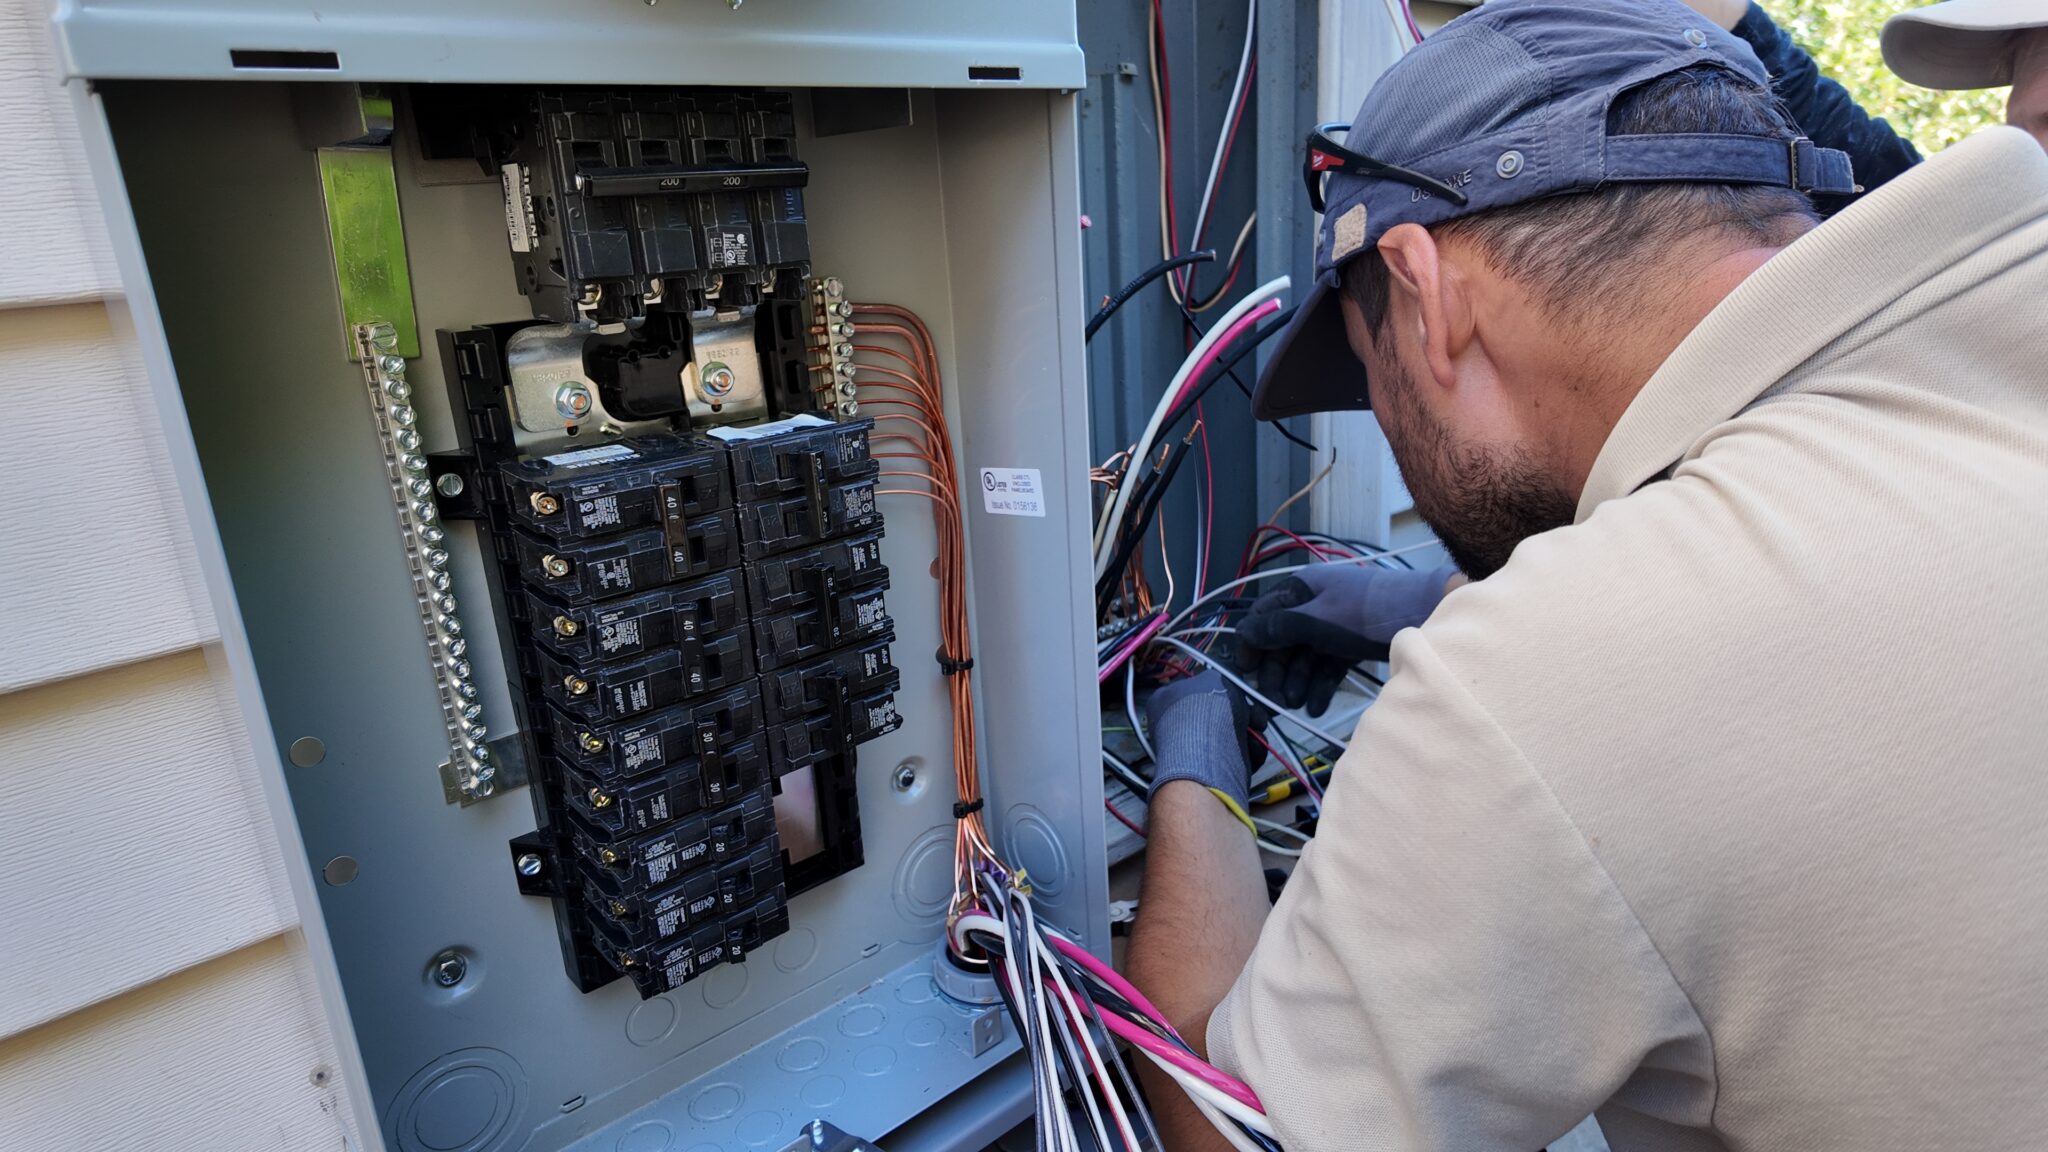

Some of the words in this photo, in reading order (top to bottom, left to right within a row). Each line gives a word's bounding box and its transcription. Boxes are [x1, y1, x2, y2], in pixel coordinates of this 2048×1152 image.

[661, 177, 680, 186] 200
[723, 176, 741, 186] 200
[523, 166, 540, 249] SIEMENS
[667, 496, 677, 509] 40
[673, 551, 684, 562] 40
[683, 620, 694, 631] 40
[690, 672, 701, 683] 40
[703, 732, 714, 743] 30
[710, 782, 720, 793] 30
[716, 842, 725, 853] 20
[723, 893, 733, 904] 20
[732, 945, 741, 956] 20
